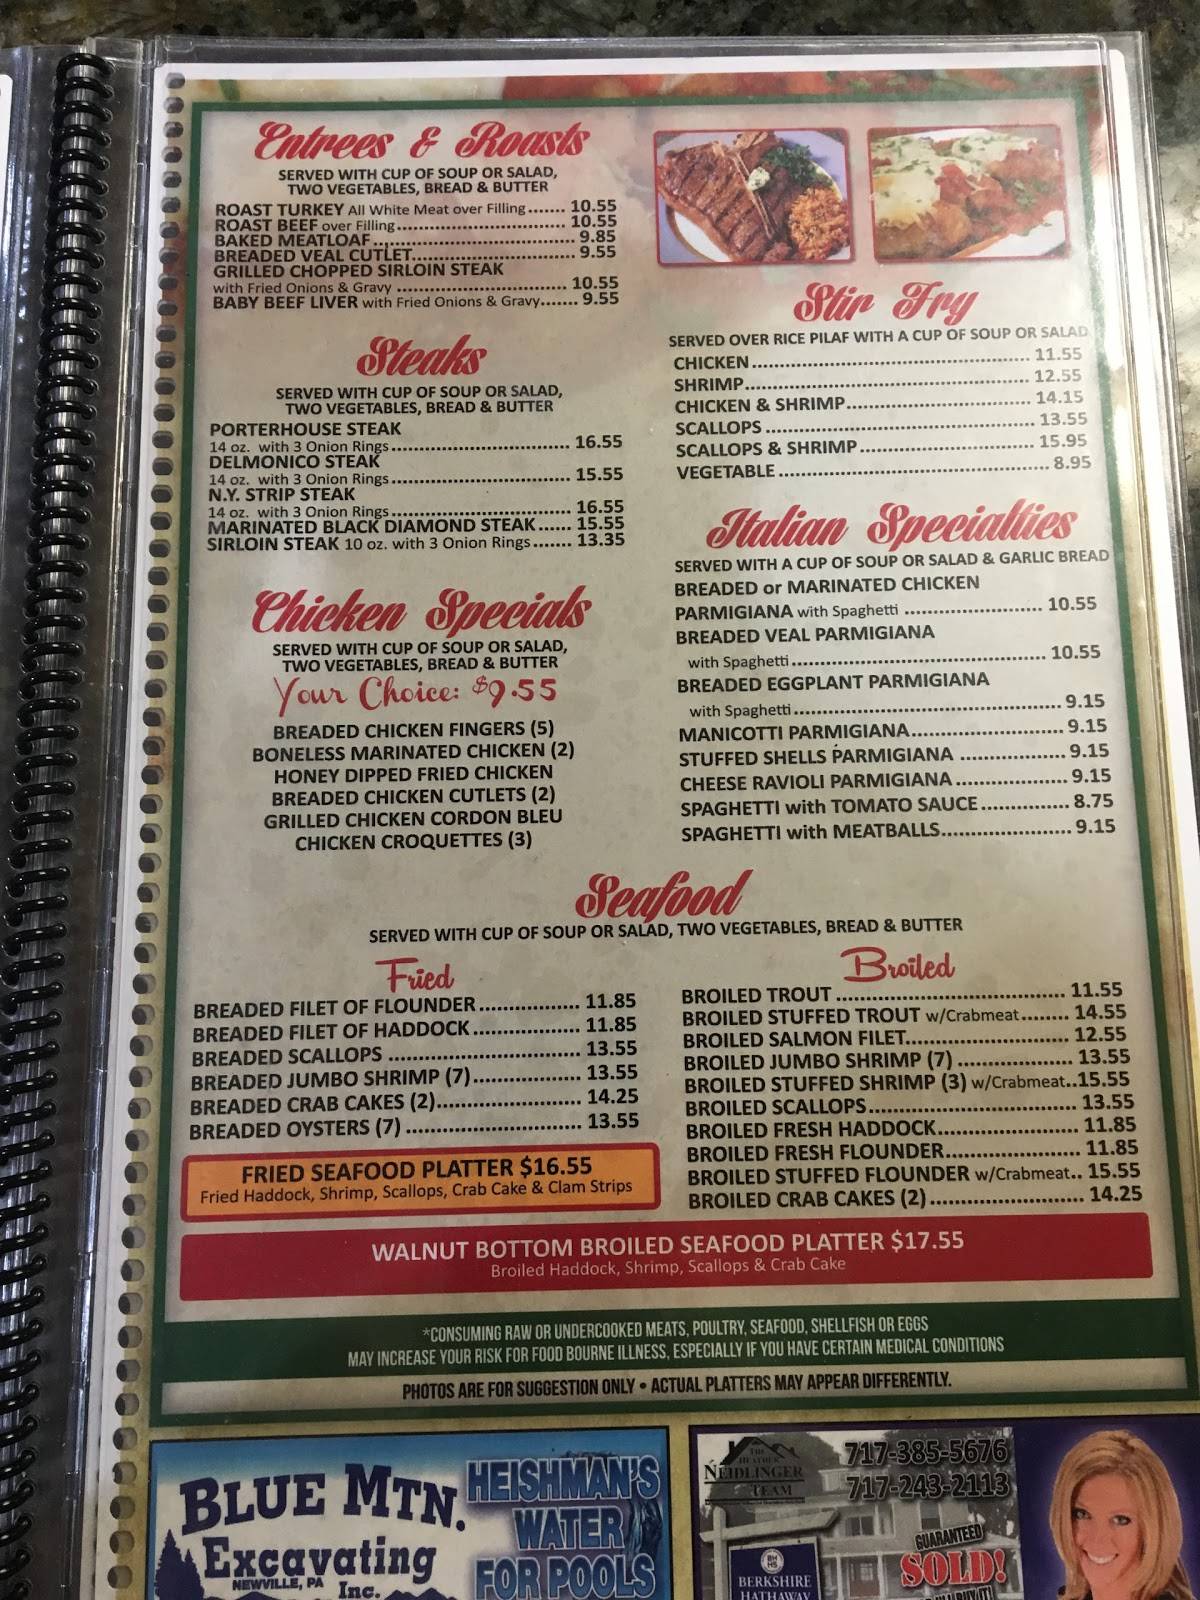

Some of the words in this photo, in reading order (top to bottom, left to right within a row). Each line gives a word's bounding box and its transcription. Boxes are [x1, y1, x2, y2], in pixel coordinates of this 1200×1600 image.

[255, 121, 394, 160] Entrees
[410, 126, 440, 157] &
[455, 121, 590, 157] Roasts
[278, 169, 334, 181] SERVED
[338, 169, 377, 180] WITH
[381, 168, 411, 180] CUP
[414, 168, 434, 180] OF
[438, 168, 478, 179] SOUP
[482, 167, 503, 178] OR
[507, 166, 557, 179] SALAD,
[288, 184, 323, 195] TWO
[327, 183, 420, 196] VEGETABLES,
[424, 182, 473, 194] BREAD
[476, 181, 489, 193] &
[493, 180, 548, 193] BUTTER
[216, 204, 273, 216] ROAST
[277, 203, 344, 216] TURKEY
[348, 204, 365, 216] All
[369, 204, 410, 216] White
[414, 204, 449, 215] Meat
[452, 206, 483, 214] over
[571, 199, 617, 212] 10.55
[213, 265, 285, 278] GRILLED
[290, 264, 373, 278] CHOPPED
[378, 263, 445, 277] SIRLOIN
[450, 262, 504, 276] STEAK
[213, 282, 243, 294] with
[248, 282, 282, 294] Fried
[286, 282, 334, 294] Onions
[338, 282, 349, 293] &
[572, 276, 619, 290] 10.55
[794, 282, 873, 321] Stir
[893, 282, 978, 325] Fry
[669, 334, 725, 348] SERVED
[729, 334, 769, 346] OVER
[774, 332, 805, 345] RICE
[810, 332, 849, 344] PILAF
[853, 330, 894, 343] WITH
[898, 330, 909, 342] A
[912, 329, 942, 342] CUP
[946, 328, 966, 340] OF
[970, 328, 1011, 340] SOUP
[1015, 326, 1037, 339] OR
[1041, 326, 1088, 338] SALAD
[356, 335, 487, 376] Steaks
[210, 422, 342, 436] PORTERHOUSE
[347, 422, 401, 436] STEAK
[1040, 412, 1088, 426] 13.55
[210, 442, 226, 453] 14
[230, 444, 250, 453] oz.
[258, 440, 289, 453] with
[294, 441, 302, 452] 3
[306, 440, 348, 452] Onion
[576, 434, 622, 449] 16.55
[707, 506, 848, 548] Italian
[867, 499, 1078, 551] Specialties
[675, 581, 758, 597] BREADED
[763, 584, 782, 595] or
[788, 578, 896, 594] MARINATED
[902, 575, 980, 591] CHICKEN
[252, 589, 407, 633] Chicken
[426, 586, 592, 637] Specials
[675, 604, 794, 620] PARMIGIANA
[797, 605, 828, 618] with
[1048, 596, 1097, 611] 10.55
[274, 677, 348, 717] Your
[359, 676, 459, 710] Choice:
[472, 676, 557, 707] $9.55
[252, 746, 345, 762] BONELESS
[351, 744, 461, 761] MARINATED
[467, 743, 545, 758] CHICKEN
[551, 741, 574, 760] (2)
[576, 869, 753, 924] Seafood
[375, 957, 454, 993] Fried
[841, 947, 955, 982] Broiled
[682, 988, 762, 1004] BROILED
[1071, 982, 1123, 998] 11.55
[190, 1122, 281, 1140] BREADED
[286, 1119, 370, 1138] OYSTERS
[376, 1117, 400, 1138] (7)
[588, 1112, 639, 1129] 13.55
[242, 1164, 304, 1184] FRIED
[311, 1161, 415, 1182] SEAFOOD
[422, 1159, 514, 1178] PLATTER
[520, 1155, 592, 1179] $16.55
[200, 1189, 239, 1204] Fried
[244, 1187, 315, 1203] Haddock,
[320, 1186, 378, 1202] Shrimp,
[383, 1184, 447, 1200] Scallops,
[452, 1182, 487, 1196] Crab
[491, 1182, 527, 1196] Cake
[532, 1181, 544, 1194] &
[548, 1181, 586, 1194] Clam
[590, 1180, 632, 1196] Strips
[372, 1241, 469, 1261] WALNUT
[476, 1239, 572, 1258] BOTTOM
[581, 1236, 674, 1256] BROILED
[681, 1234, 784, 1254] SEAFOOD
[792, 1232, 884, 1252] PLATTER
[891, 1229, 964, 1253] $17.55
[492, 1263, 544, 1278] Broiled
[550, 1261, 620, 1276] Haddock,
[625, 1260, 683, 1276] Shrimp,
[688, 1259, 749, 1275] Scallops
[754, 1258, 766, 1272] &
[771, 1257, 806, 1271] Crab
[810, 1257, 846, 1270] Cake
[505, 1324, 532, 1340] RAW
[535, 1324, 551, 1340] OR
[554, 1322, 642, 1339] UNDERCOOKED
[646, 1321, 689, 1337] MEATS,
[693, 1320, 747, 1336] POULTRY,
[750, 1318, 808, 1335] SEAFOOD,
[811, 1317, 875, 1333] SHELLFISH
[878, 1316, 895, 1332] OR
[898, 1316, 928, 1332] EGGS
[402, 1382, 455, 1399] PHOTOS
[458, 1382, 485, 1398] ARE
[488, 1381, 513, 1397] FOR
[516, 1379, 598, 1397] SUGGESTION
[602, 1378, 635, 1395] ONLY
[651, 1376, 703, 1394] ACTUAL
[706, 1375, 772, 1392] PLATTERS
[774, 1374, 804, 1391] MAY
[807, 1373, 860, 1390] APPEAR
[862, 1371, 952, 1389] DIFFERENTLY.
[844, 1438, 1008, 1465] 717-385-5676
[466, 1455, 661, 1504] HEISHMAN'S
[704, 1464, 803, 1480] NEIDLINGER
[754, 1484, 792, 1497] TEAM
[846, 1472, 1009, 1500] 717-243-2113
[513, 1506, 624, 1550] WATER
[915, 1524, 982, 1550] GUARANTEED
[203, 1536, 436, 1584] Excavating
[901, 1549, 1006, 1587] SOLD!
[232, 1578, 303, 1590] NEWVILLE,
[307, 1578, 323, 1588] PA
[475, 1558, 539, 1600] FOR
[546, 1553, 657, 1599] POOLS
[739, 1575, 811, 1587] BERKSHIRE
[339, 1581, 380, 1599] Inc.
